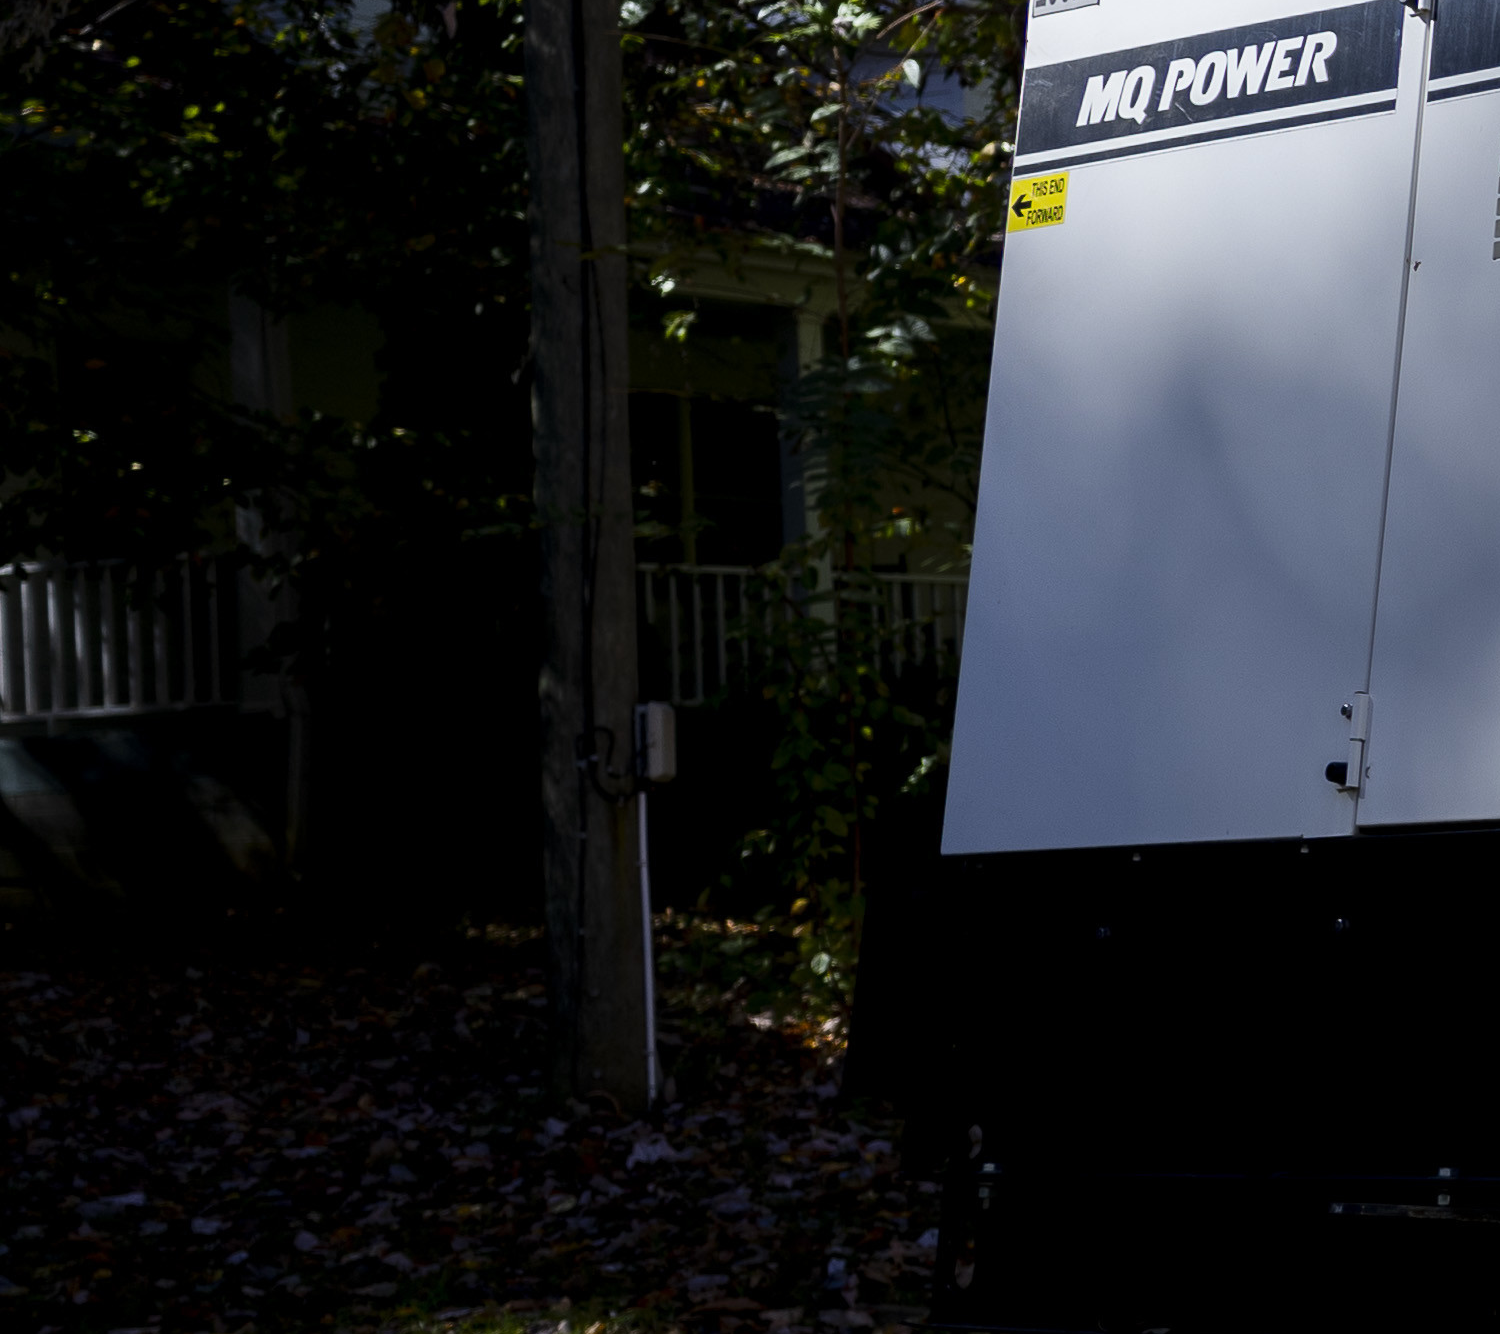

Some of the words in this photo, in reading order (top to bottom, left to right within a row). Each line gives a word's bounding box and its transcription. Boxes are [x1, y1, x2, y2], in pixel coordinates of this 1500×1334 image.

[1075, 65, 1155, 127] MQ
[1158, 30, 1338, 111] POWER
[1031, 179, 1048, 198] THIS
[1049, 177, 1065, 195] END
[1025, 204, 1064, 226] FORWARD
